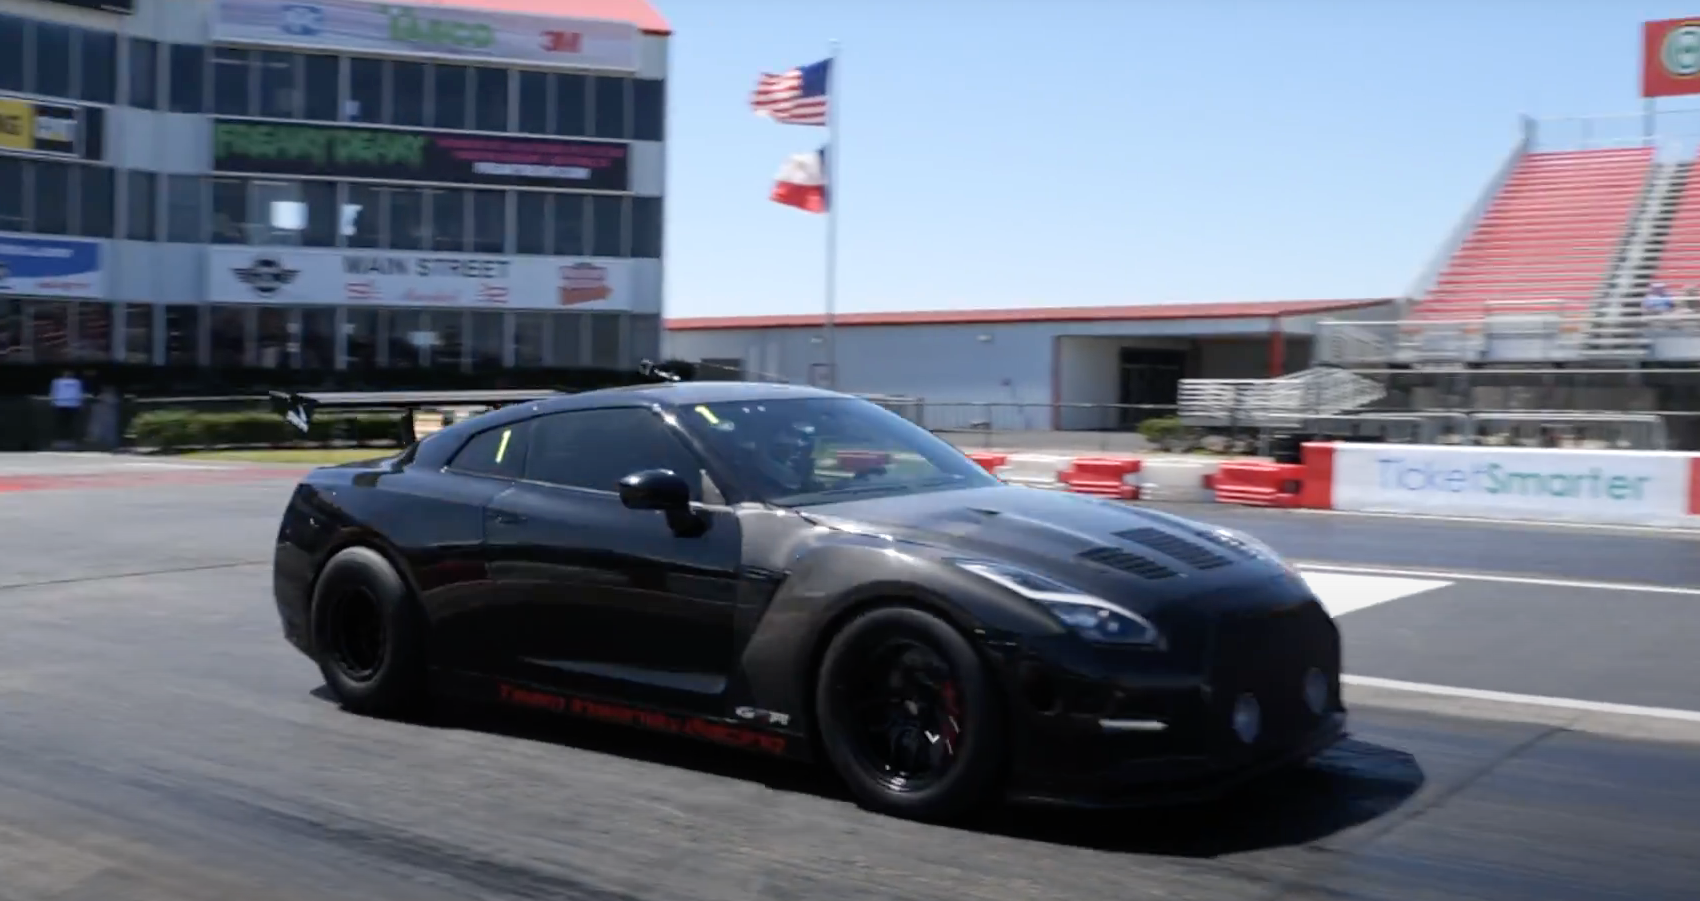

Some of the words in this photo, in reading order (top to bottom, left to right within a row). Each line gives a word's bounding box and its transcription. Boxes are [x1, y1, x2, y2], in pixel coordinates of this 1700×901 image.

[538, 30, 583, 53] 3M
[416, 258, 510, 278] STREET
[495, 429, 511, 463] 1
[1377, 458, 1652, 500] TicketSmarter
